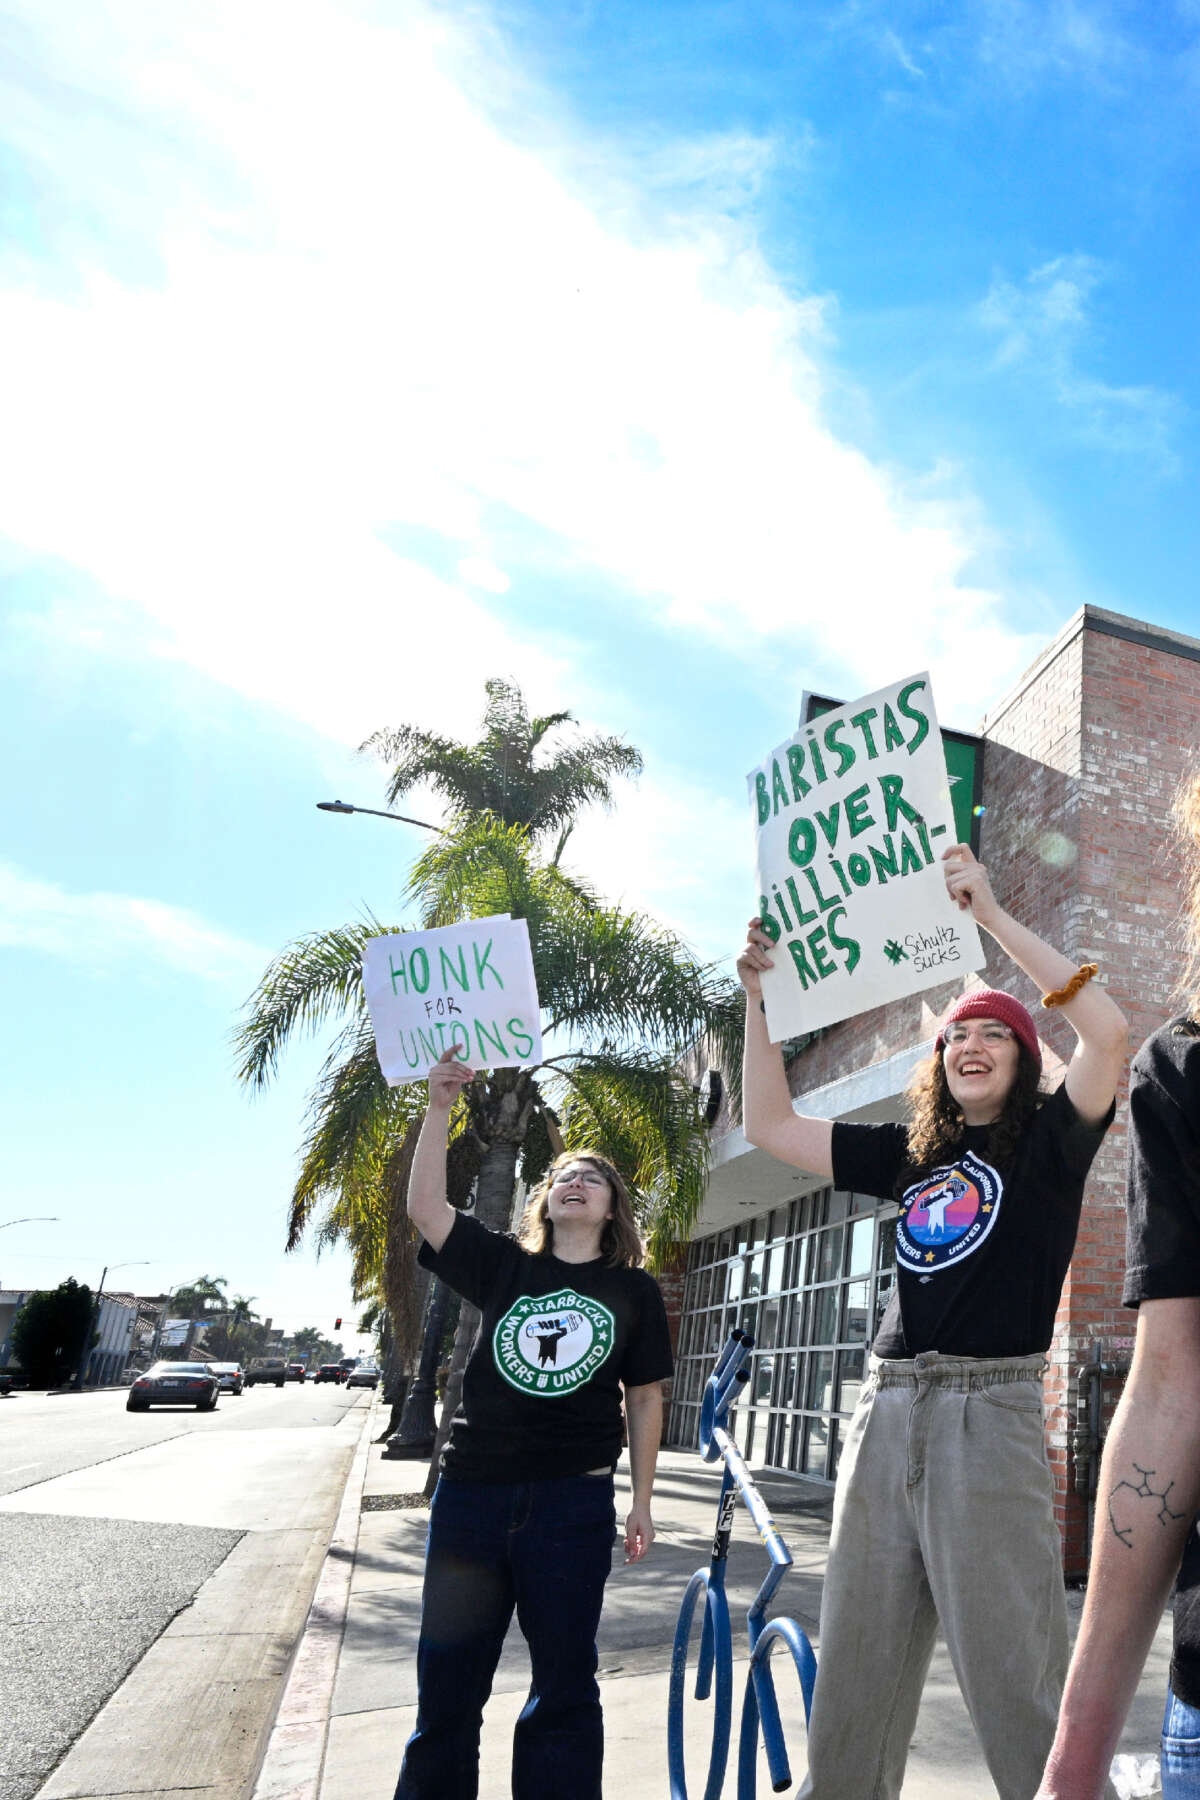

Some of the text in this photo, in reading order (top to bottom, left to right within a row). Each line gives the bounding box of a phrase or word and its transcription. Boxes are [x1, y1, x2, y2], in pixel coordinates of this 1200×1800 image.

[788, 774, 918, 867] OVER
[389, 938, 504, 996] HONK
[787, 906, 861, 990] RES
[424, 997, 462, 1019] FOR
[400, 1018, 534, 1069] UNIONS
[949, 1223, 981, 1255] UNITED
[530, 1295, 608, 1328] STARBUCKS
[501, 1315, 604, 1387] WORKERS UNITED
